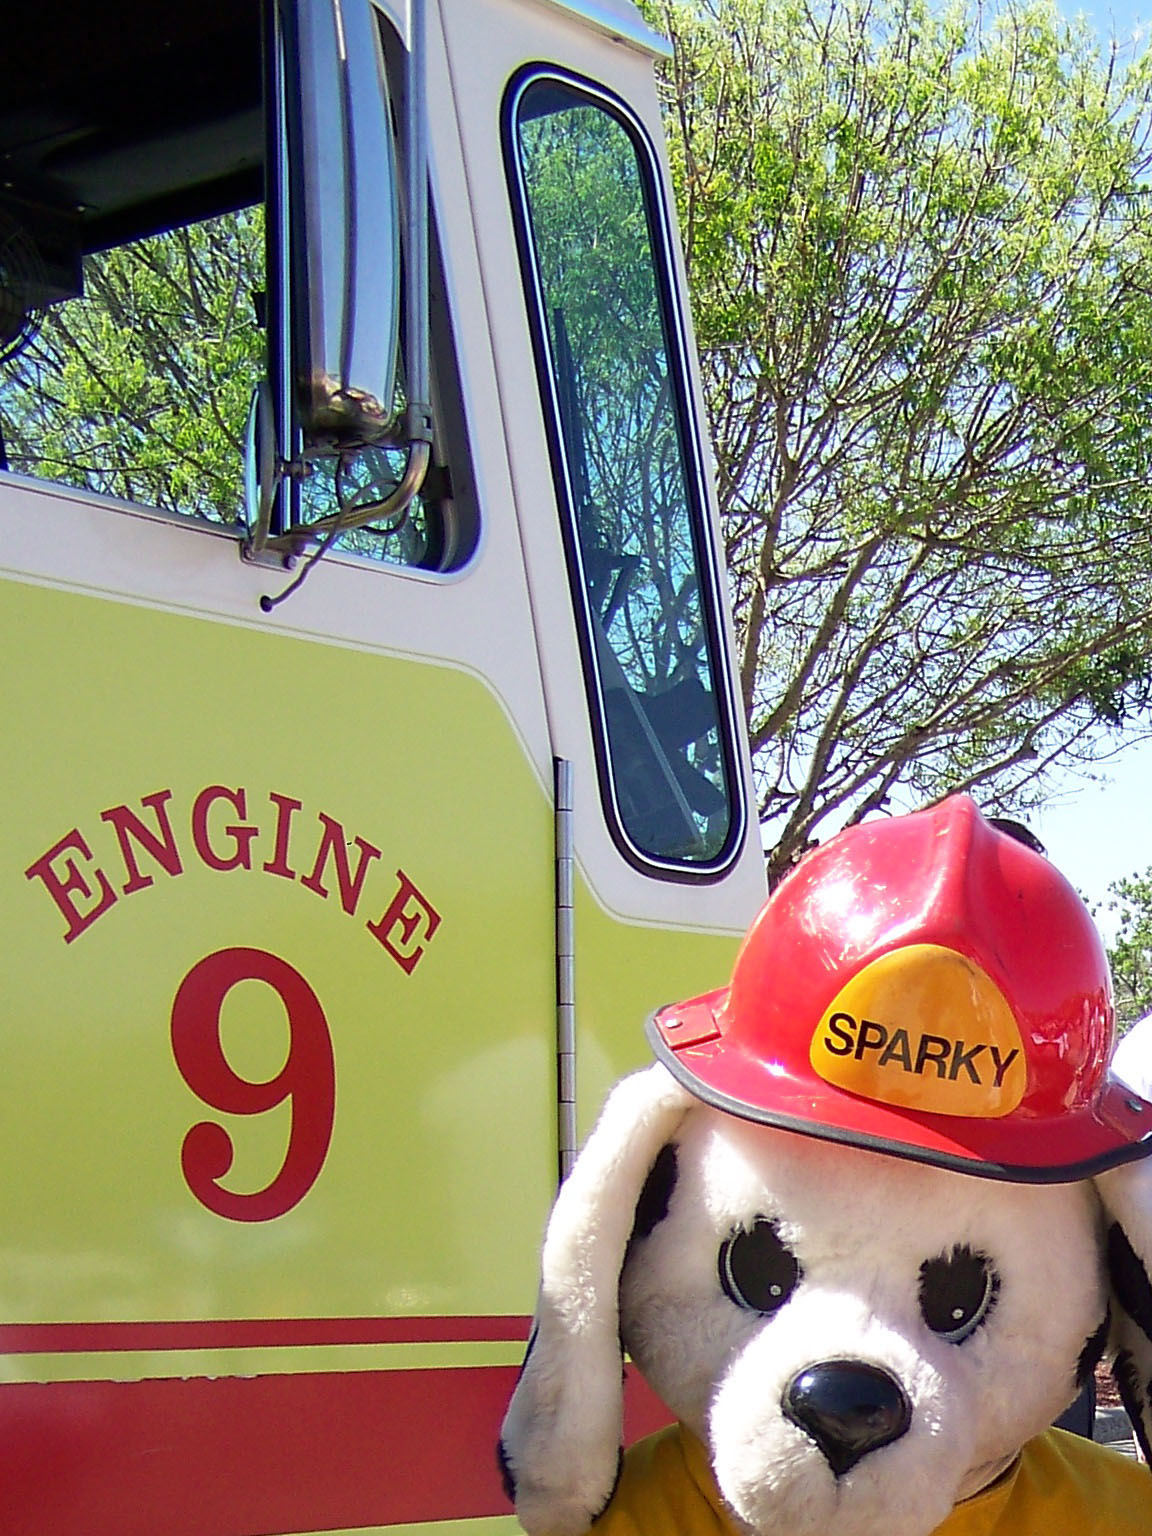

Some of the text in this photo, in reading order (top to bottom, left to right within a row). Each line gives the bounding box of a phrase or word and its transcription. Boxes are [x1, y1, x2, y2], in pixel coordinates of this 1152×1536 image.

[24, 785, 442, 976] ENGINE
[170, 946, 336, 1223] 9
[824, 1012, 1019, 1088] SPARKY
